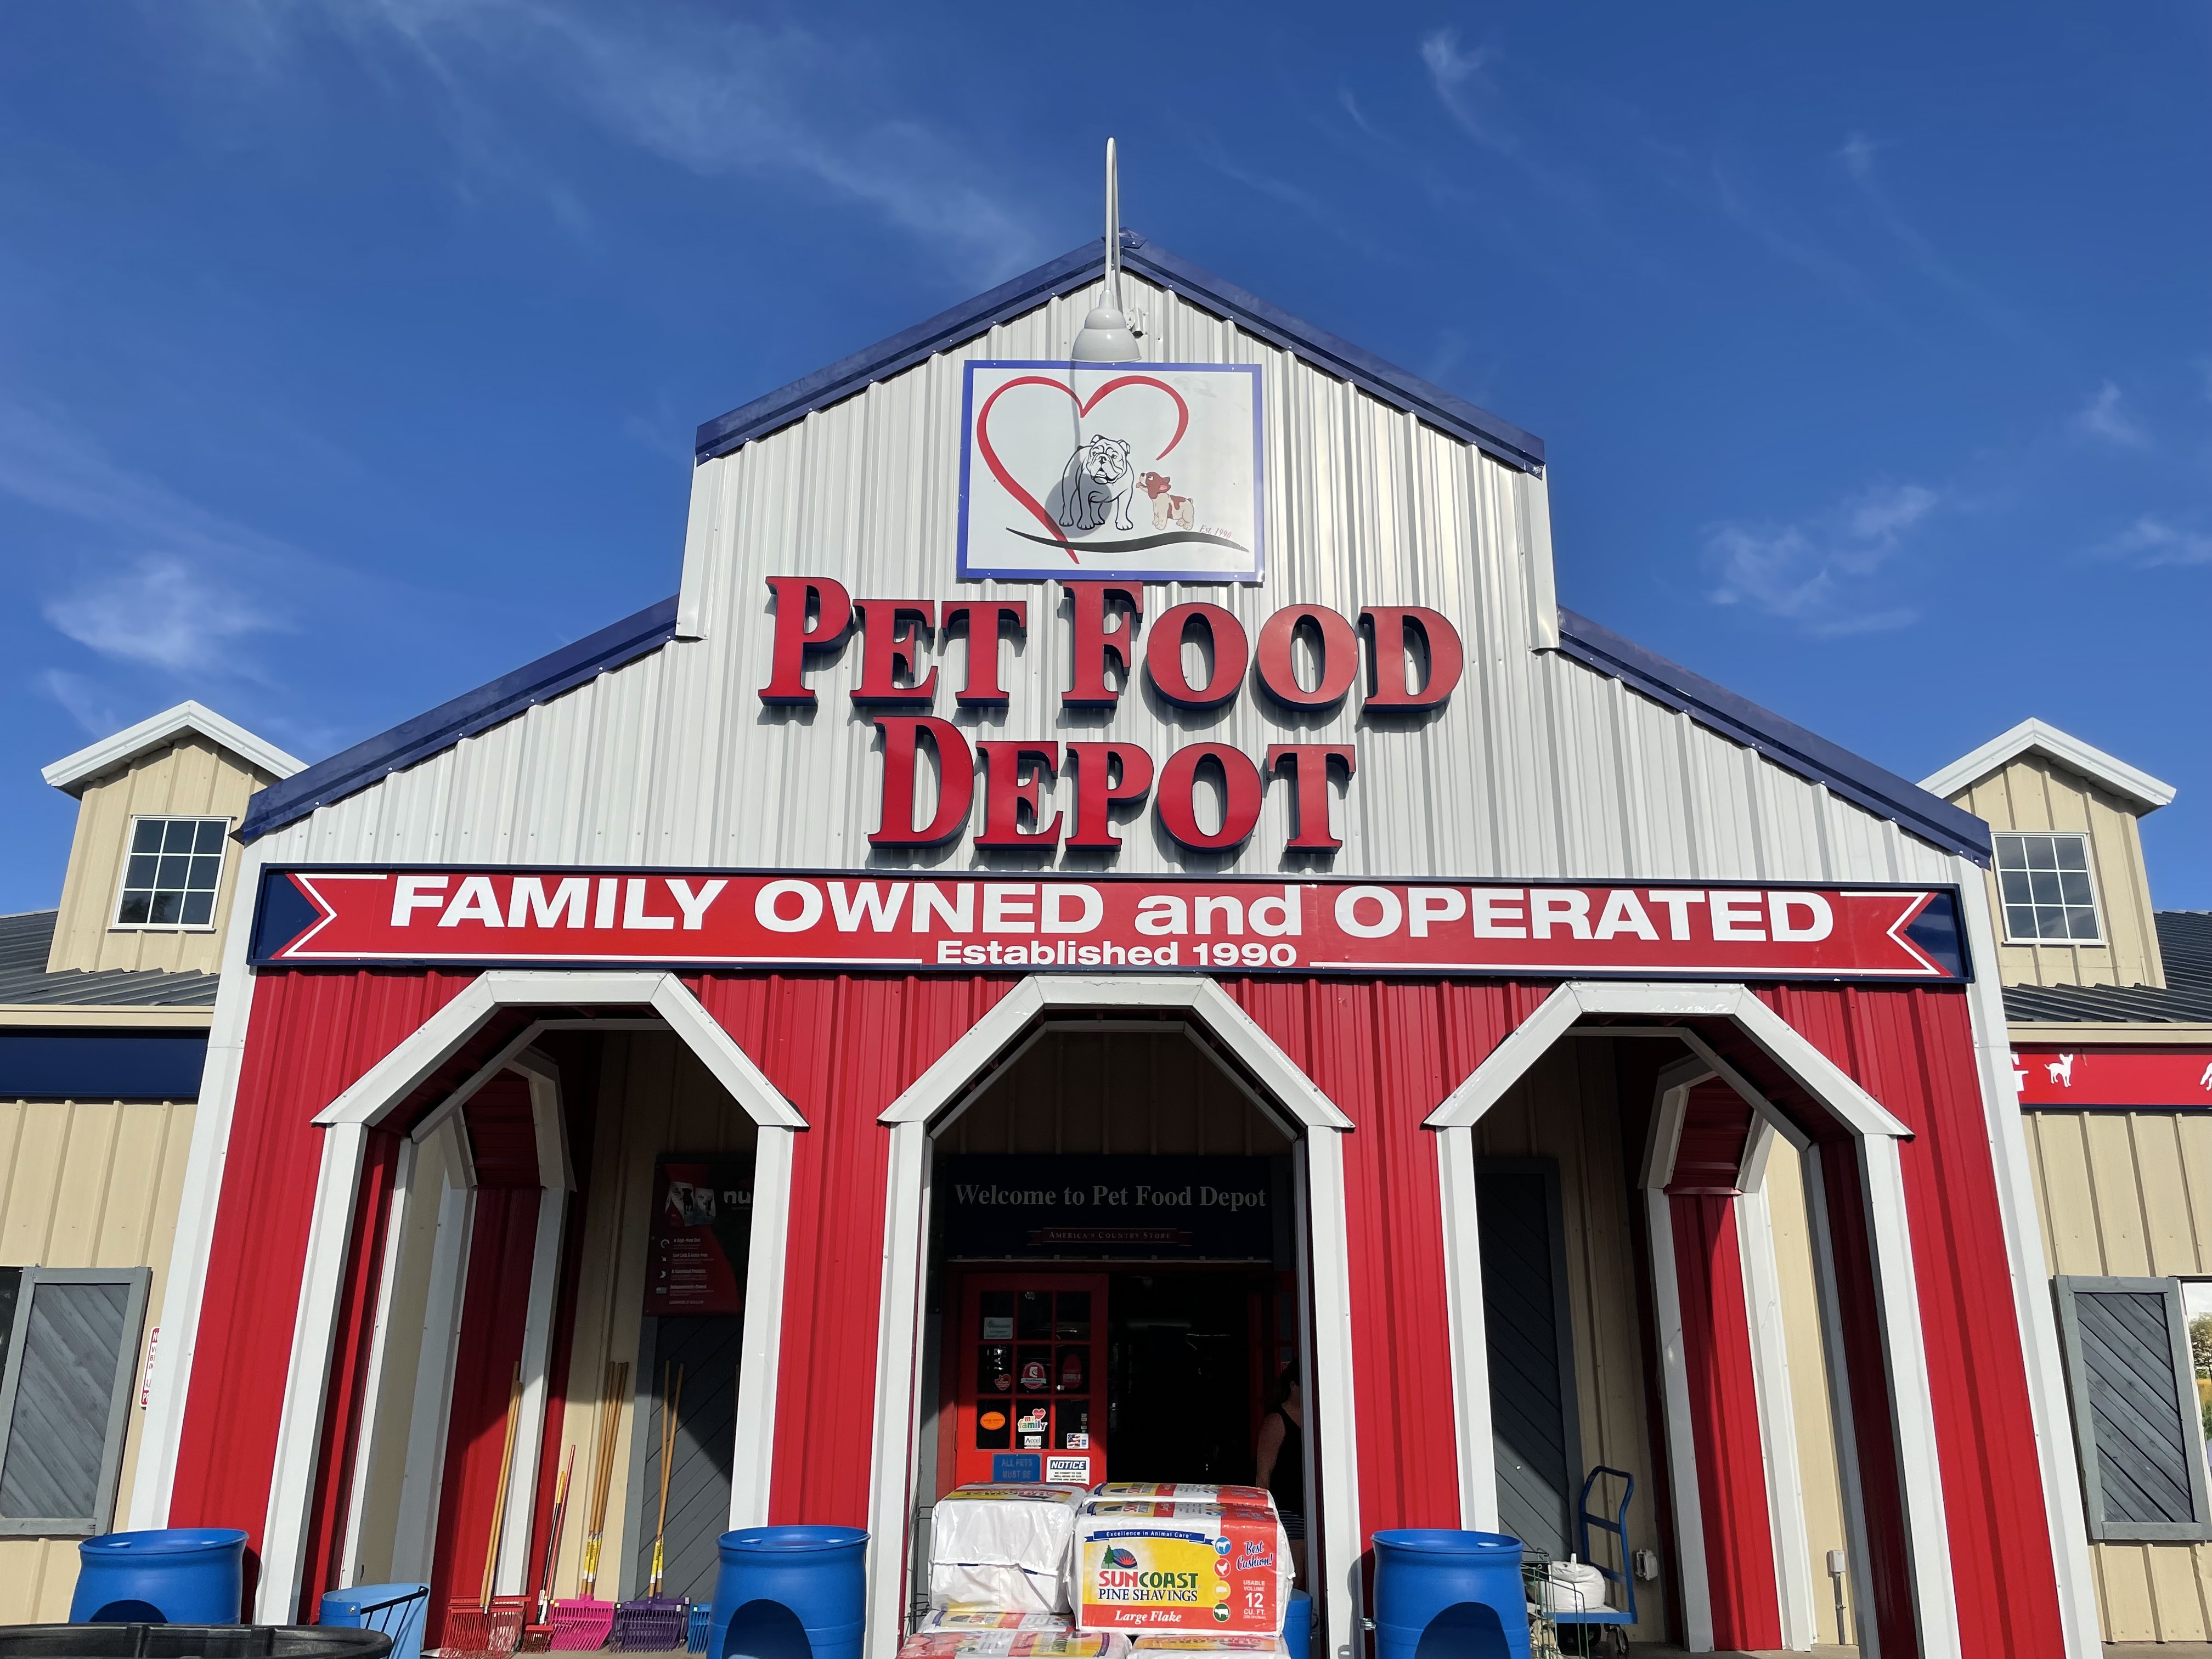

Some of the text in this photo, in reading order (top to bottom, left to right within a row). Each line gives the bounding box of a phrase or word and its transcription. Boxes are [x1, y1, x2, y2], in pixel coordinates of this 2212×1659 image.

[1199, 524, 1232, 539] Est. 1990
[758, 576, 1464, 708] PET FOOD
[867, 715, 1356, 851] DEPOT
[391, 876, 1833, 942] FAMILY OWNED and OPERATED
[937, 940, 1297, 967] Established 1990
[954, 1183, 1267, 1211] Welcome to Pet Food Depot
[1019, 1419, 1045, 1430] family
[1001, 1458, 1014, 1467] ALL
[1051, 1461, 1085, 1469] NOTICE
[1002, 1470, 1020, 1479] MUST
[1244, 1541, 1265, 1556] Best
[1237, 1553, 1273, 1571] Cushion!
[1098, 1571, 1199, 1589] SUNCOAST
[1098, 1588, 1198, 1602] PINE SHAVINGS
[1245, 1592, 1263, 1608] 12
[1114, 1610, 1182, 1624] Large Flake
